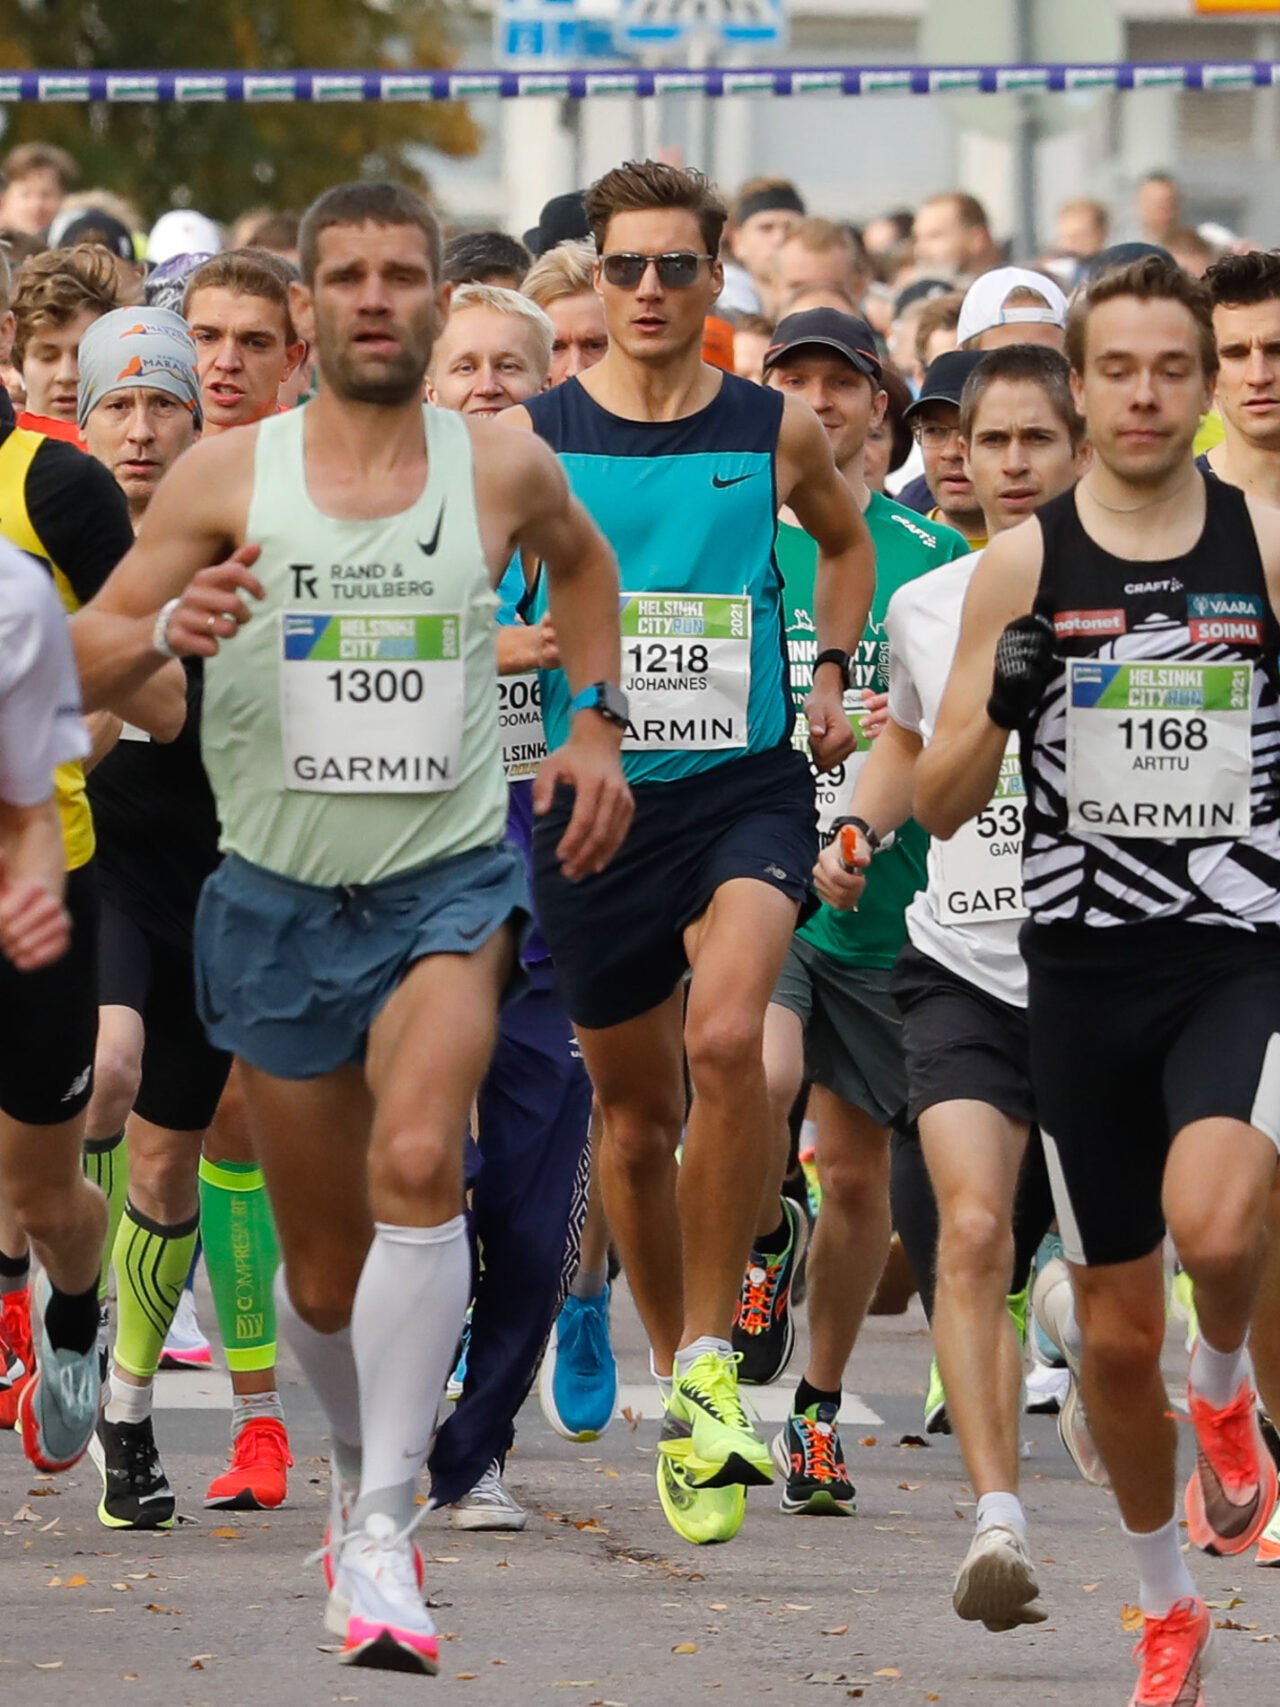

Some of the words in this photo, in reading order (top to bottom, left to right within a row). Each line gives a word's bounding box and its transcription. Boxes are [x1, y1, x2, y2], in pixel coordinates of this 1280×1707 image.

[331, 564, 386, 580] RAND
[392, 563, 404, 578] &
[331, 581, 434, 599] TUULBERG
[1124, 580, 1171, 595] CRAFT
[637, 600, 704, 617] HELSINKI
[1210, 601, 1257, 615] VAARA
[730, 603, 744, 637] 2021
[1198, 622, 1258, 640] SOIMU
[628, 643, 709, 674] 1218
[327, 669, 424, 703] 1300
[626, 677, 708, 691] JOHANNES
[1129, 669, 1204, 687] HELSINKI
[1230, 670, 1246, 708] 2021
[622, 717, 734, 742] ARMIN
[1117, 717, 1208, 751] 1168
[294, 756, 451, 782] GARMIN
[1132, 756, 1190, 771] ARTTU
[1078, 800, 1235, 828] GARMIN
[947, 886, 1019, 914] GAR
